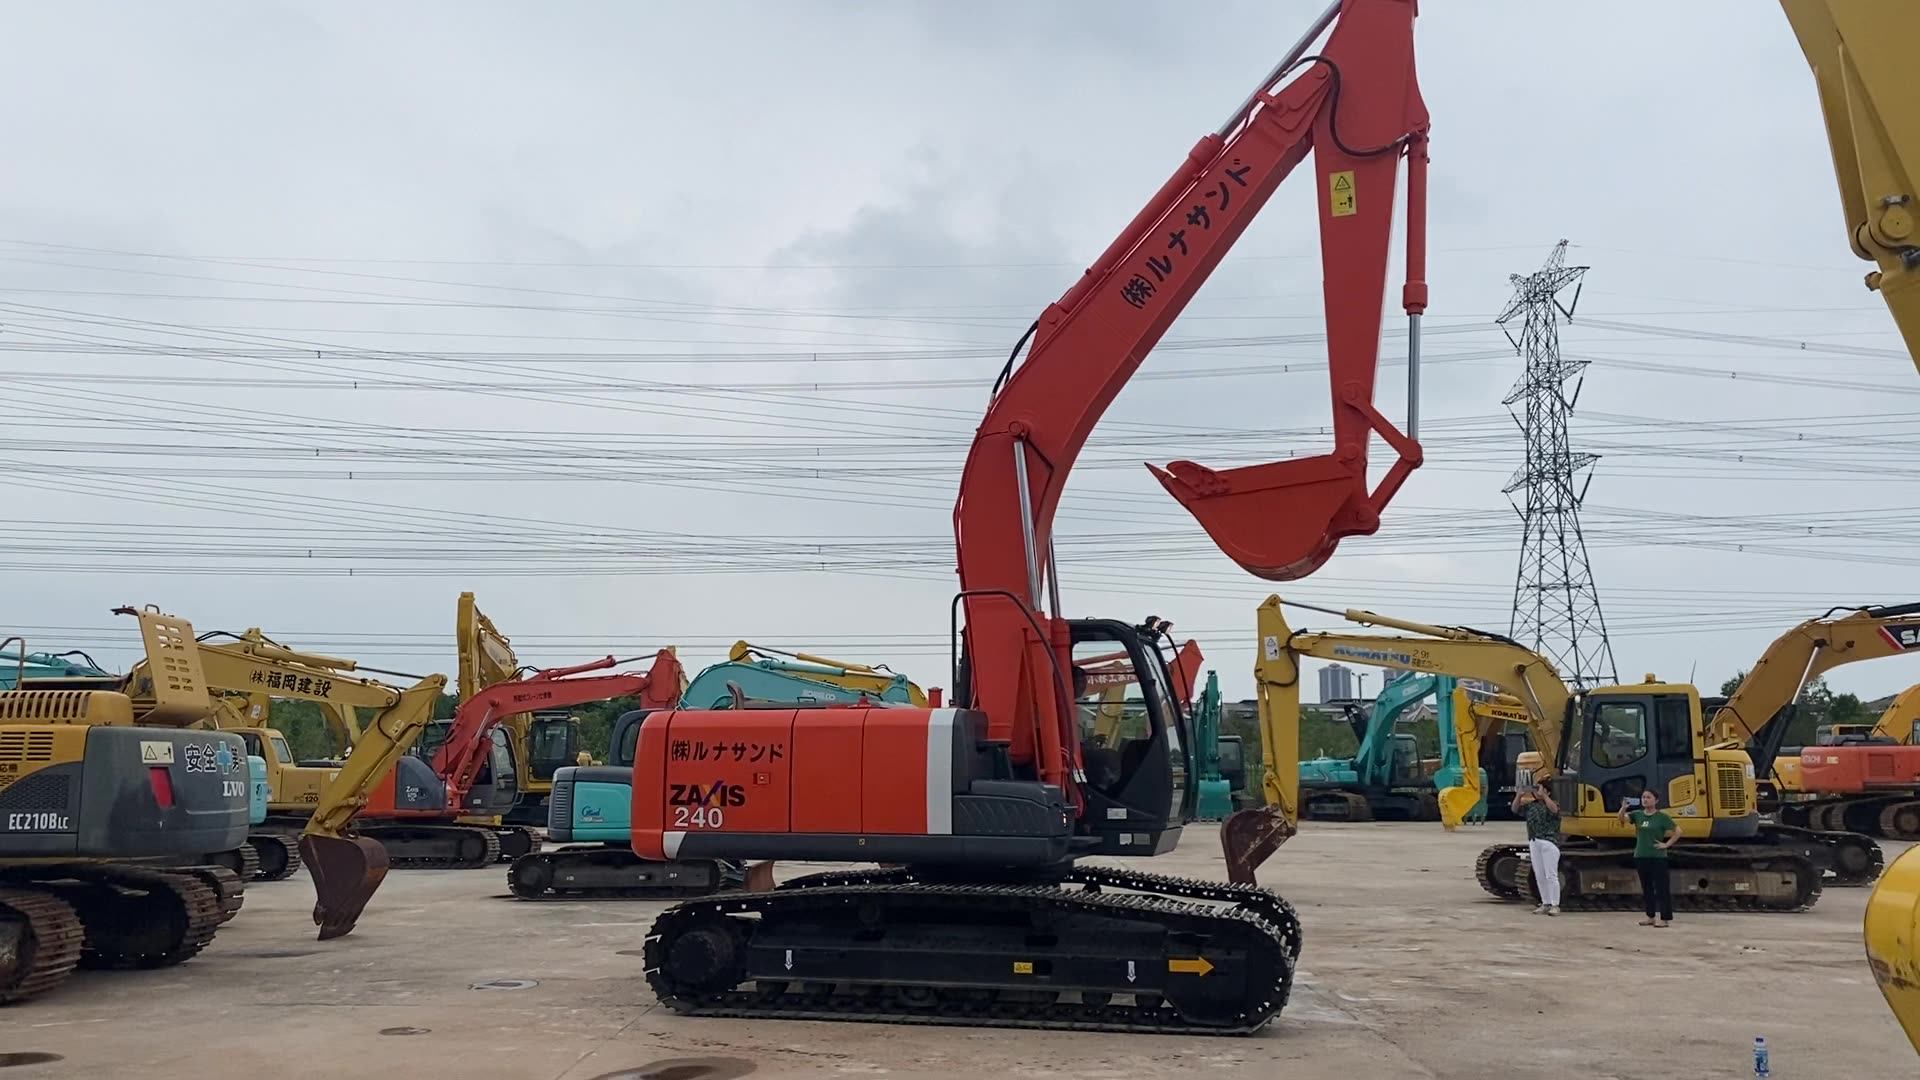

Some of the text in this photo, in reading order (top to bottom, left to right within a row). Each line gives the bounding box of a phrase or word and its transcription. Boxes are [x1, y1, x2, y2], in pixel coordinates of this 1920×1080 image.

[1120, 159, 1251, 309] (株)ルナサンド
[1901, 628, 1920, 645] S
[1491, 709, 1528, 721] KOMATSU
[671, 740, 783, 763] (株)ルナサンド
[669, 780, 746, 807] ZAXIS
[674, 807, 724, 829] 240
